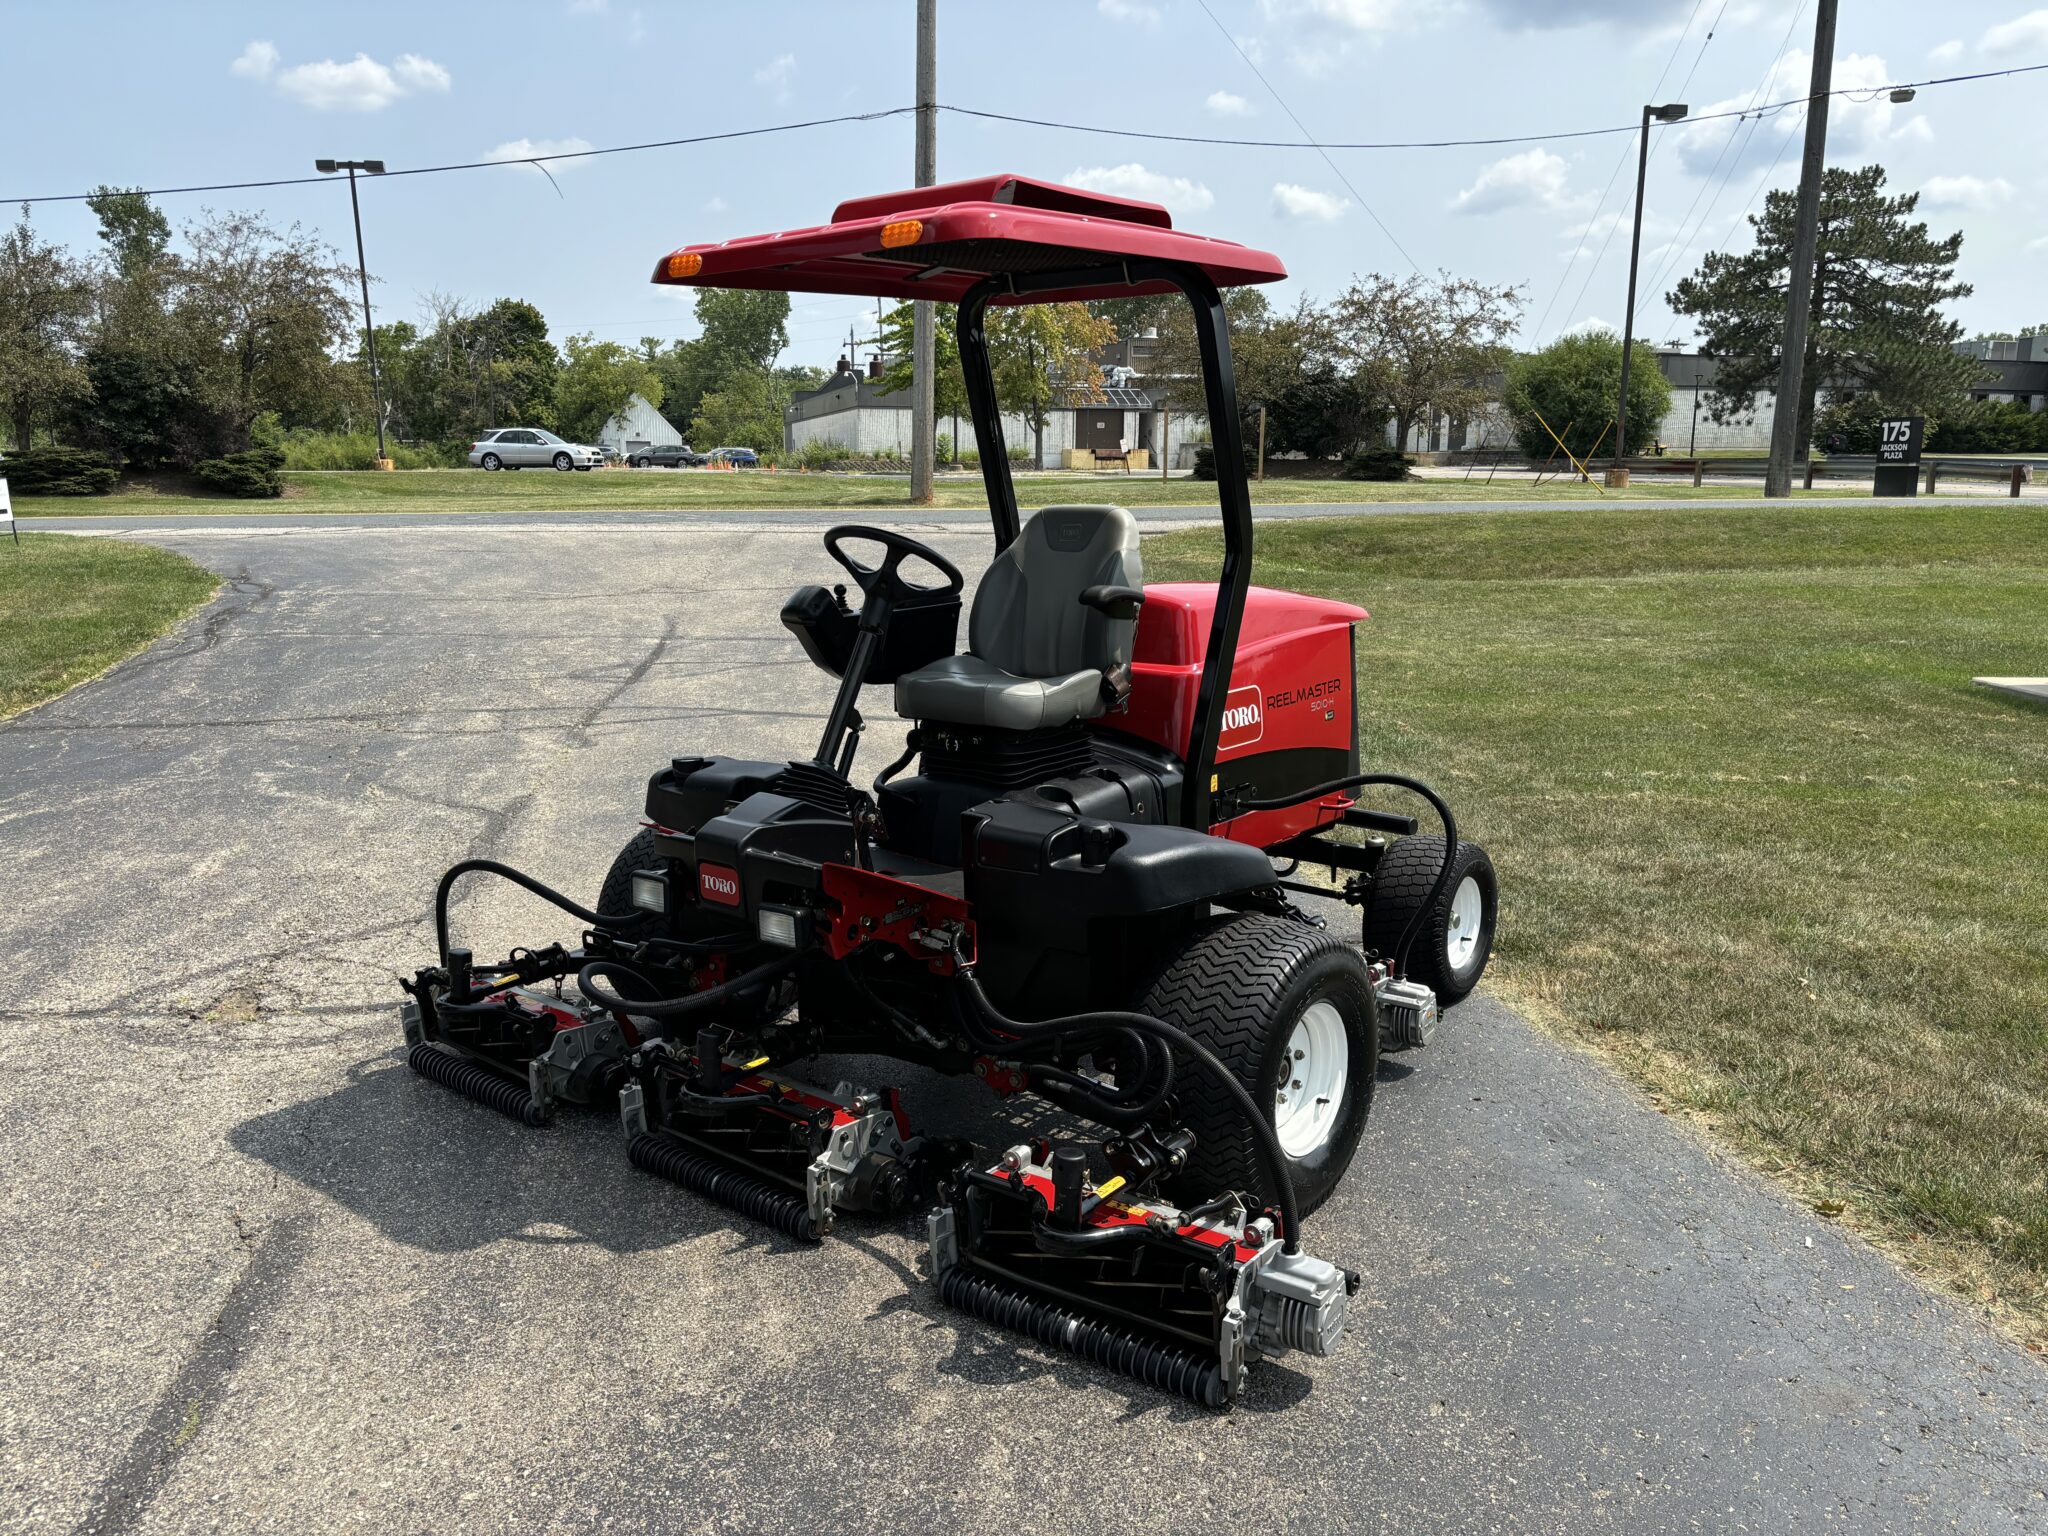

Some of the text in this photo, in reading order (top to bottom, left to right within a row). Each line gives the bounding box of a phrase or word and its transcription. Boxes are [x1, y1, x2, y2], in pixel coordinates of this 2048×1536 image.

[1881, 421, 1911, 442] 175
[1880, 443, 1908, 452] JACKSON
[1267, 679, 1341, 711] REELMASTER
[702, 874, 736, 895] TORO
